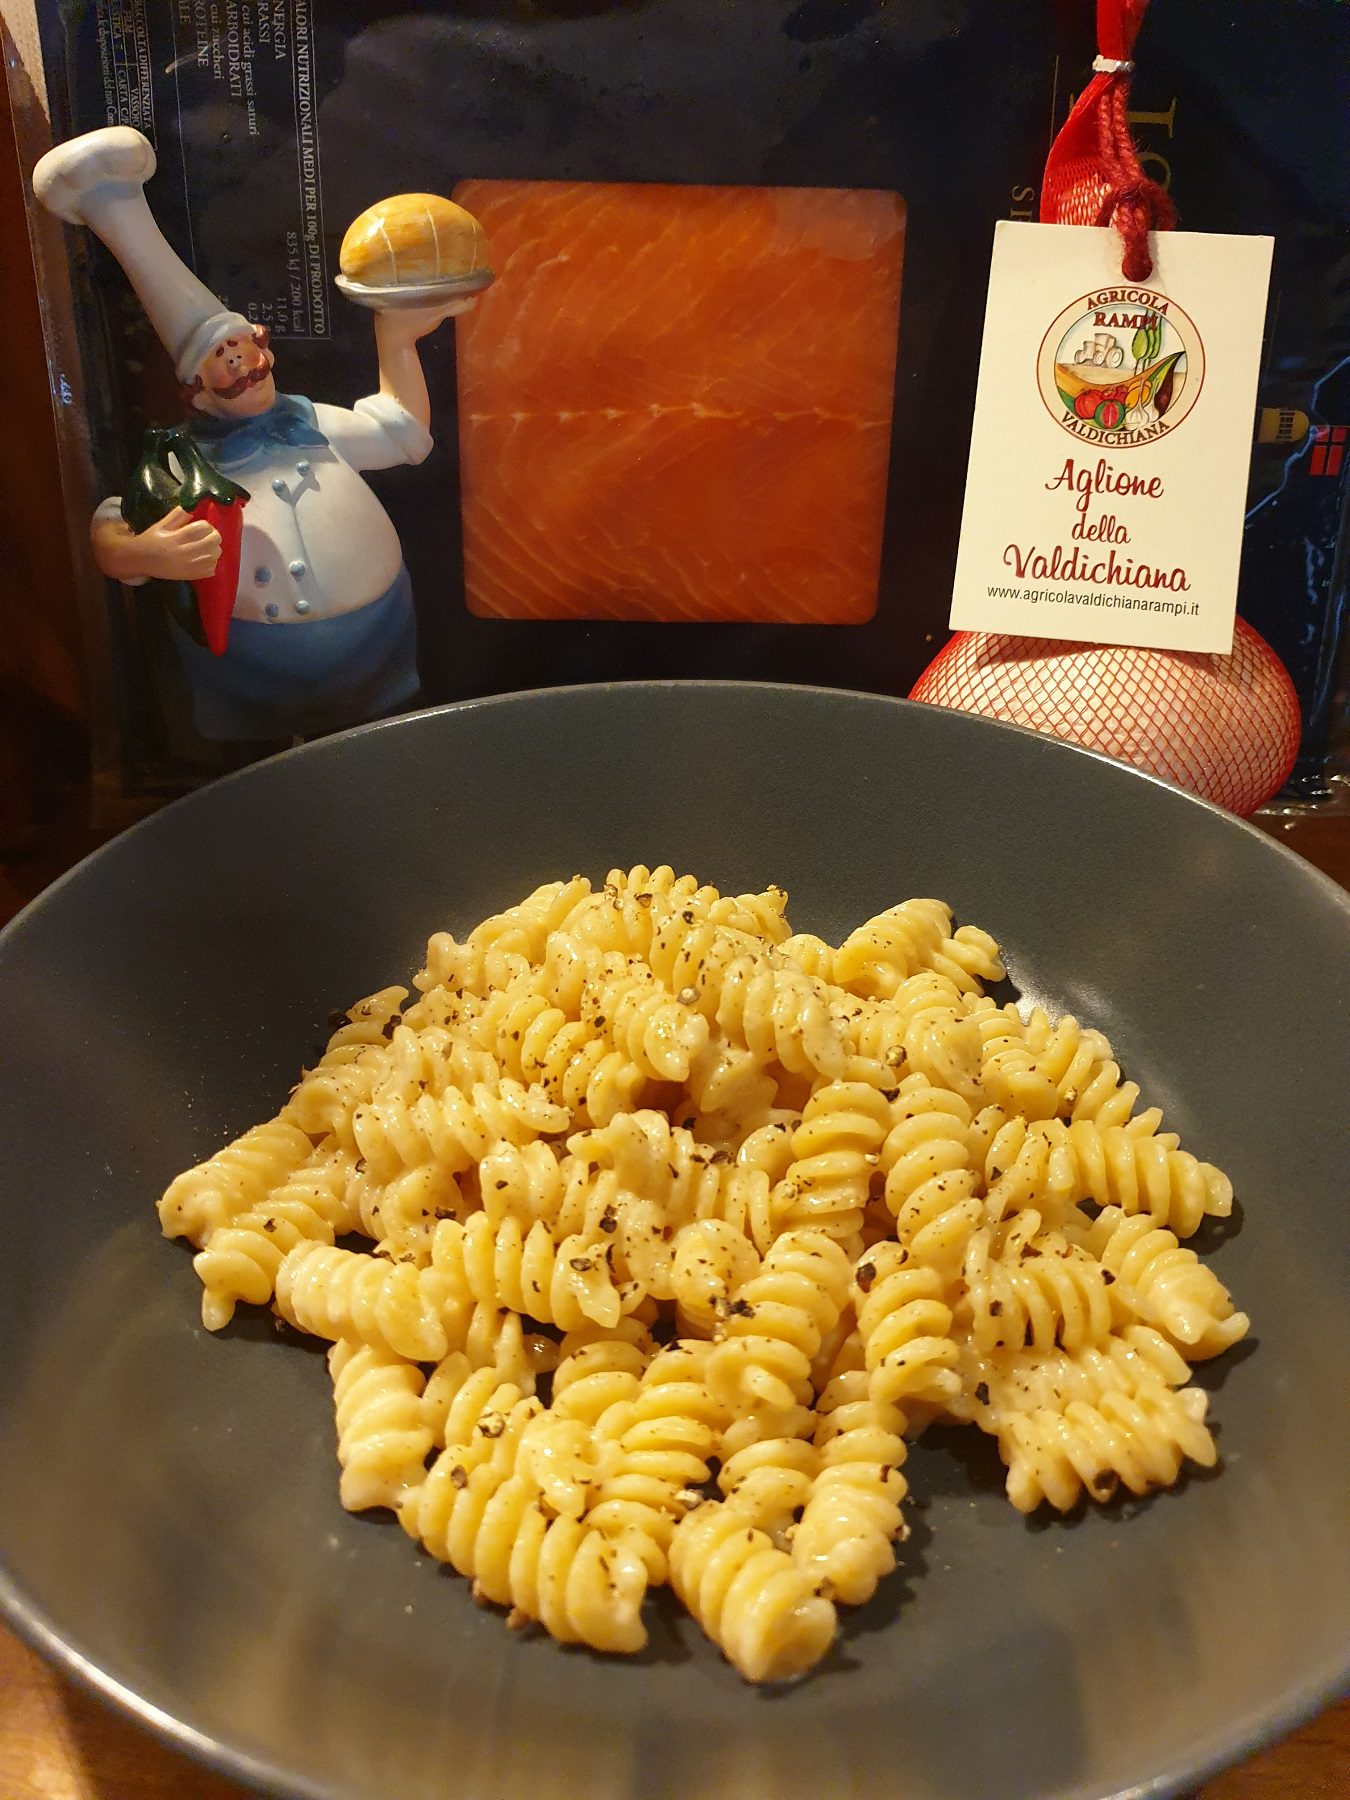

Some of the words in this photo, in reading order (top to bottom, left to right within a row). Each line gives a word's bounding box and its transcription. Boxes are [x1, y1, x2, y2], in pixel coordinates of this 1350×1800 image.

[210, 4, 222, 23] cui
[242, 5, 253, 25] cui
[257, 0, 270, 43] RASSI
[212, 28, 224, 79] zuccheri
[243, 29, 255, 58] acidi
[117, 70, 128, 102] CARTA
[139, 55, 152, 128] DIFFERENZIATA
[241, 62, 256, 96] grassi
[296, 44, 313, 143] NUTRIZIONALI
[131, 88, 140, 126] VASSOIO
[247, 100, 259, 135] saturi
[302, 147, 315, 183] MEDI
[305, 187, 316, 211] PER
[286, 232, 298, 254] 835
[305, 215, 318, 241] 100g
[309, 245, 320, 258] DI
[291, 284, 302, 306] 200
[310, 263, 325, 334] PRODOTTO
[1087, 290, 1169, 316] AGRICOLA
[293, 310, 305, 332] kcal
[1093, 312, 1158, 330] RAMPI
[1061, 411, 1170, 445] VALDICHIANA
[1045, 459, 1164, 512] Aglione
[1071, 513, 1131, 544] della
[1003, 544, 1191, 592] Valdichiana
[987, 585, 1200, 616] www.agricolavaldichianarampi.it
